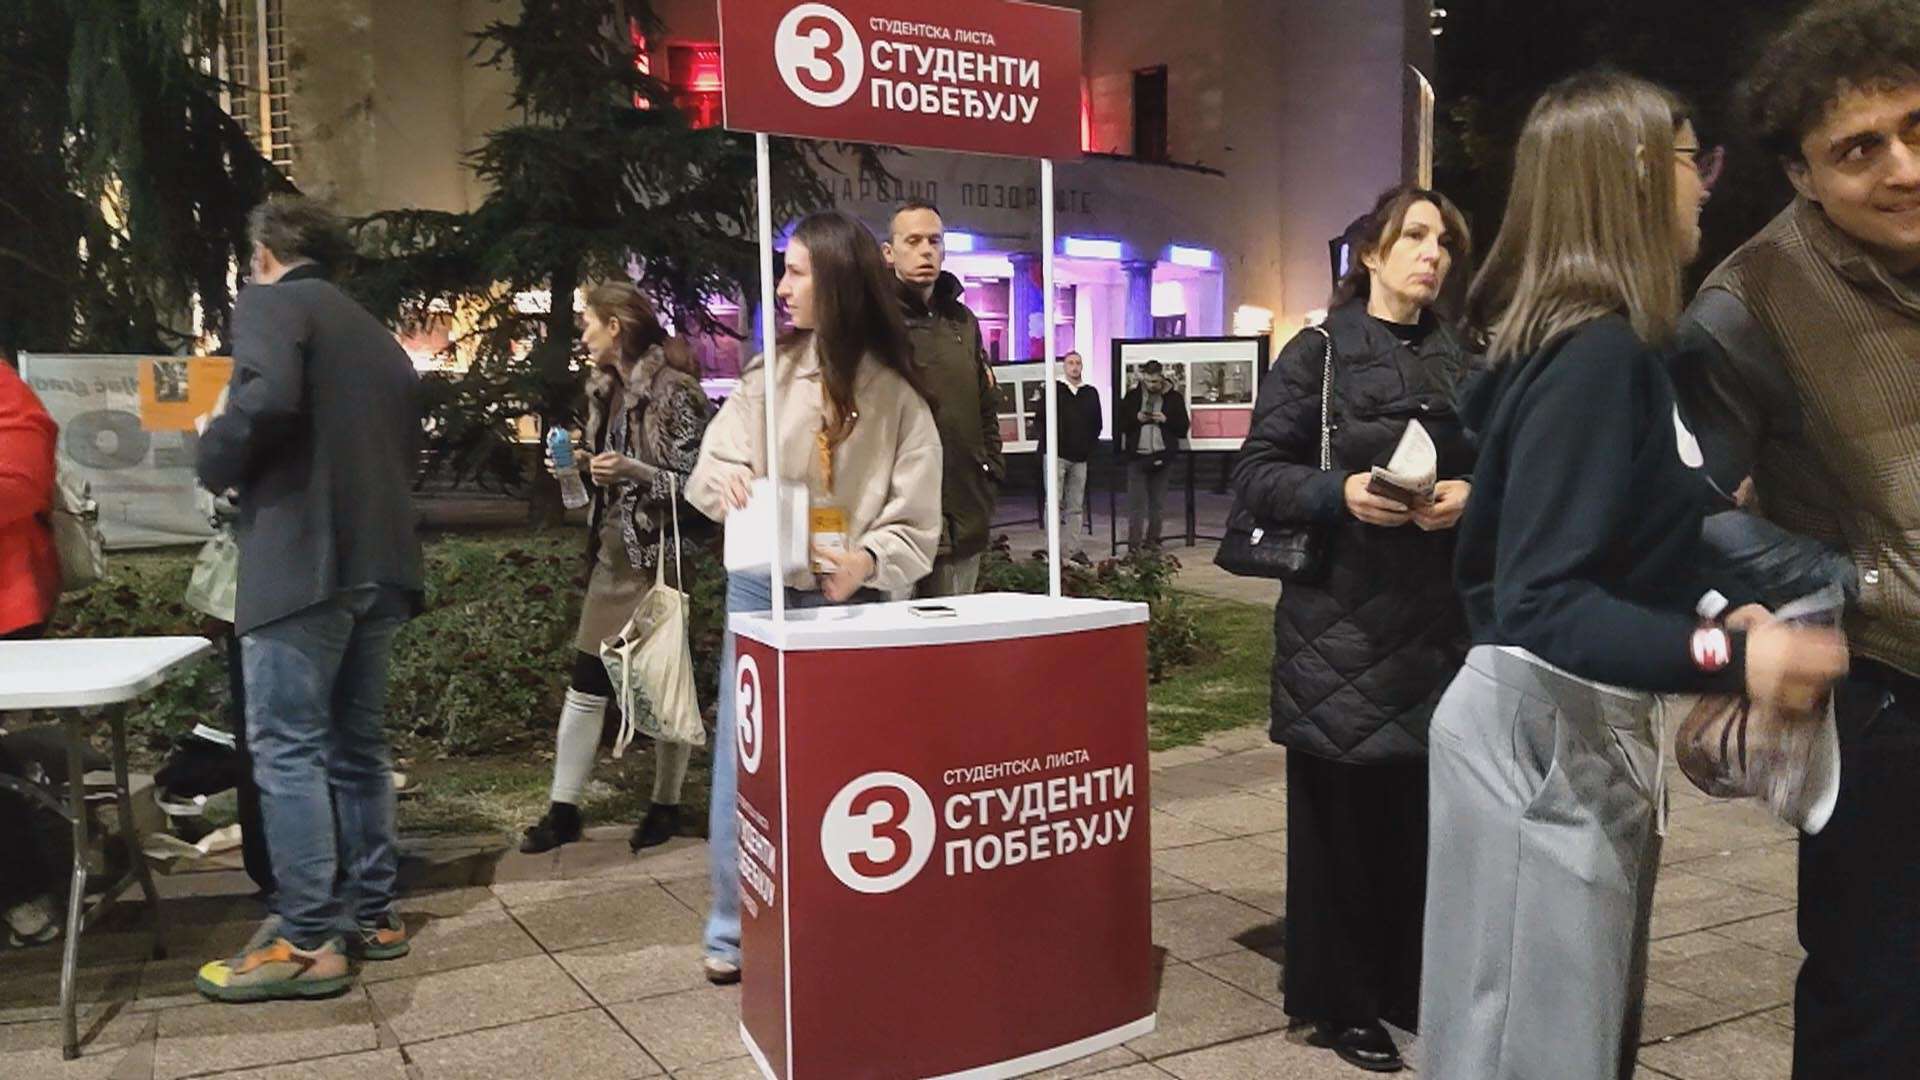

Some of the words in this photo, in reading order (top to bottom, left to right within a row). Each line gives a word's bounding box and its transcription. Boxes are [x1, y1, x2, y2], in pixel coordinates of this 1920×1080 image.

[795, 16, 847, 93] 3
[869, 17, 951, 40] СТУДЕНТСКА
[953, 27, 996, 46] ЛИСТА
[869, 40, 1041, 90] СТУДЕНТИ
[869, 78, 1040, 124] ПОБЕЂУЈУ
[961, 183, 1092, 213] ПОЗОРШТЕ
[943, 758, 1041, 786] СТУДЕНТСКА
[1044, 749, 1090, 770] ЛИСТА
[944, 764, 1134, 831] СТУДЕНТИ
[847, 784, 912, 878] 3
[944, 806, 1134, 876] ПОБЕЂУЈУ
